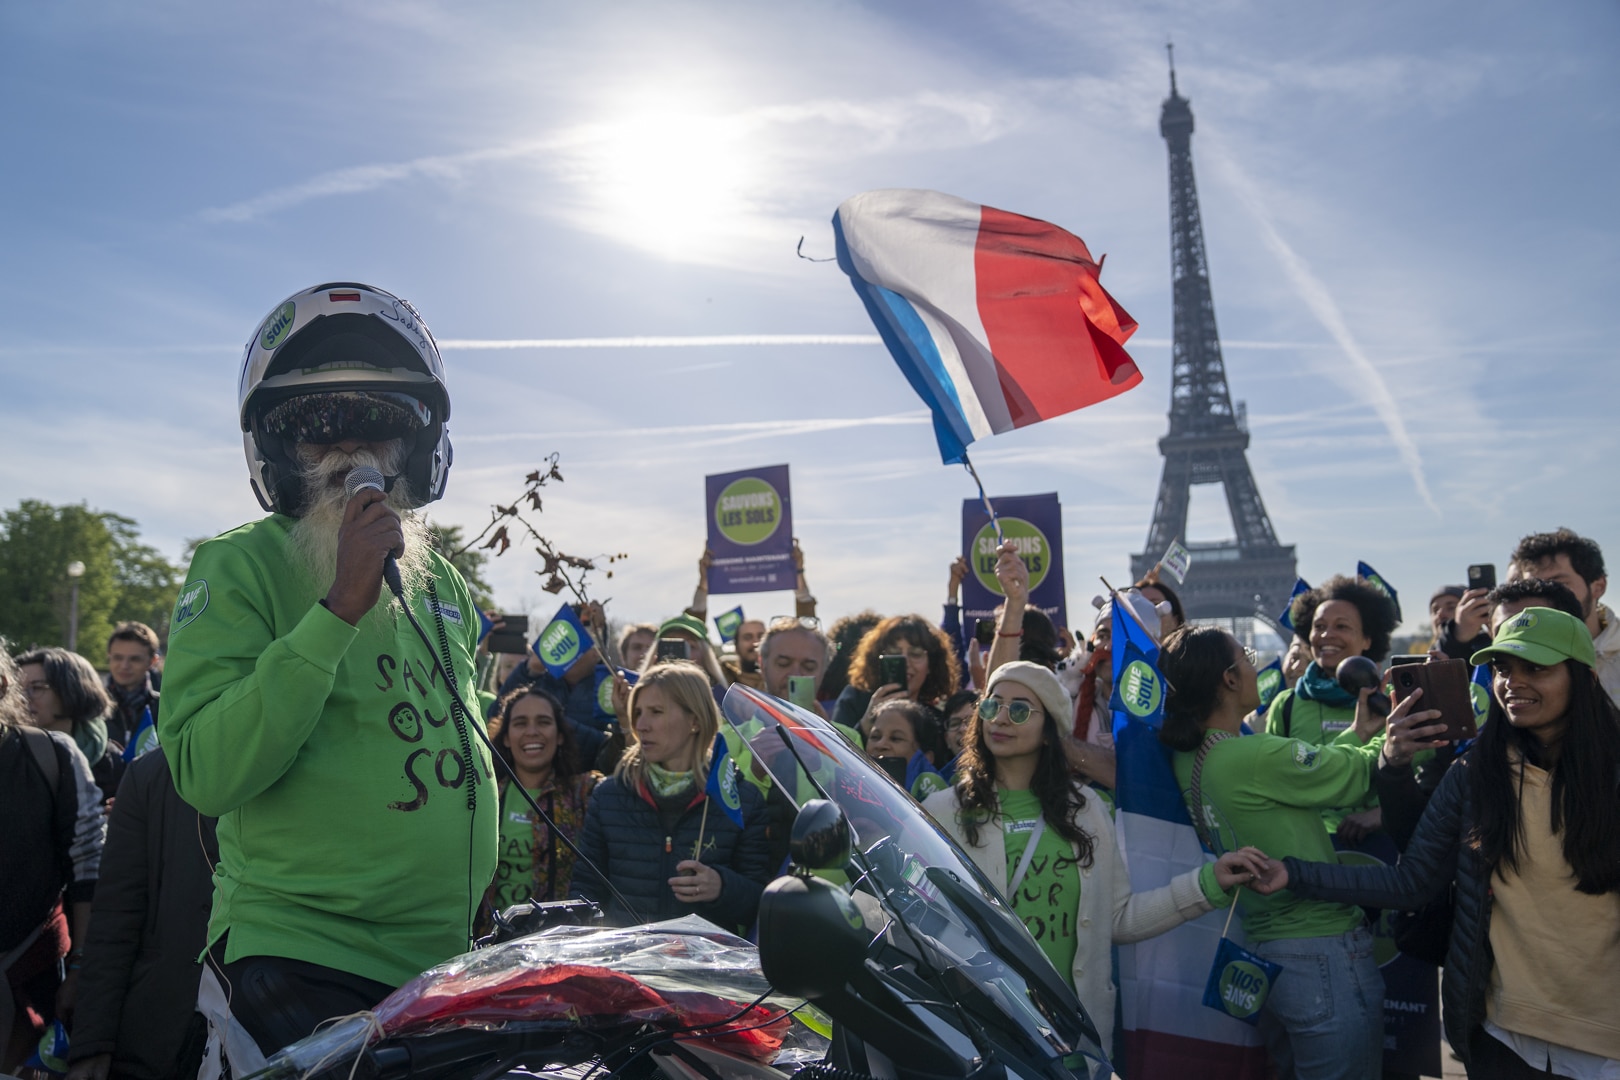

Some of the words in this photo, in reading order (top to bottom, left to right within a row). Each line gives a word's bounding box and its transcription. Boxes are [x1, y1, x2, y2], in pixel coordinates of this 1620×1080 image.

[266, 315, 291, 345] SOIL
[723, 511, 743, 527] LES
[746, 508, 775, 525] SOLS
[979, 537, 1041, 555] SAONS
[542, 623, 569, 652] SAVE
[550, 635, 577, 661] SOIL
[375, 654, 450, 699] SAV
[1126, 666, 1142, 704] SAVE
[1137, 675, 1154, 710] SOIL
[388, 701, 461, 742] OU
[1231, 964, 1263, 995] SOIL
[1223, 984, 1256, 1010] SAVE
